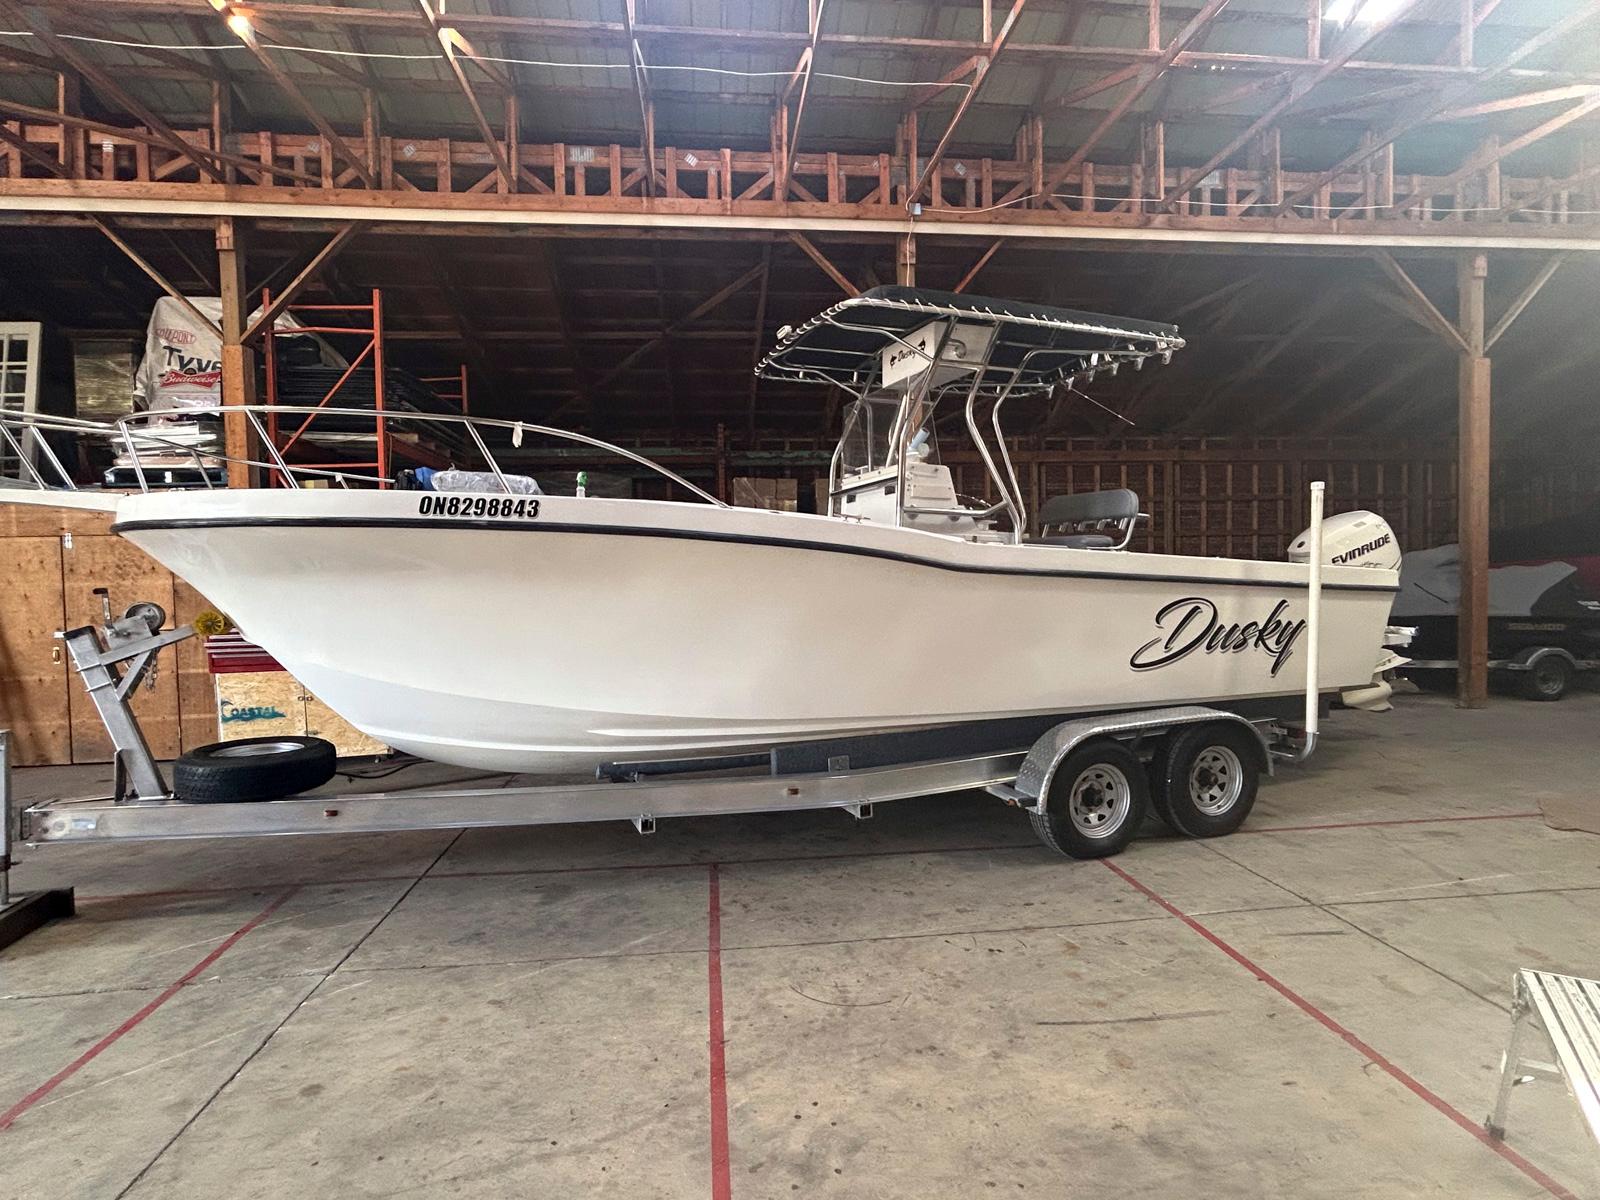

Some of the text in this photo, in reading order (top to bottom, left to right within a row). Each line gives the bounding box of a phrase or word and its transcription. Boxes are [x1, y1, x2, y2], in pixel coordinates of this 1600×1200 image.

[163, 346, 222, 373] Tyve
[419, 496, 541, 518] ON8298843
[1331, 533, 1391, 564] EVINRUDE
[1130, 597, 1307, 678] Dusky
